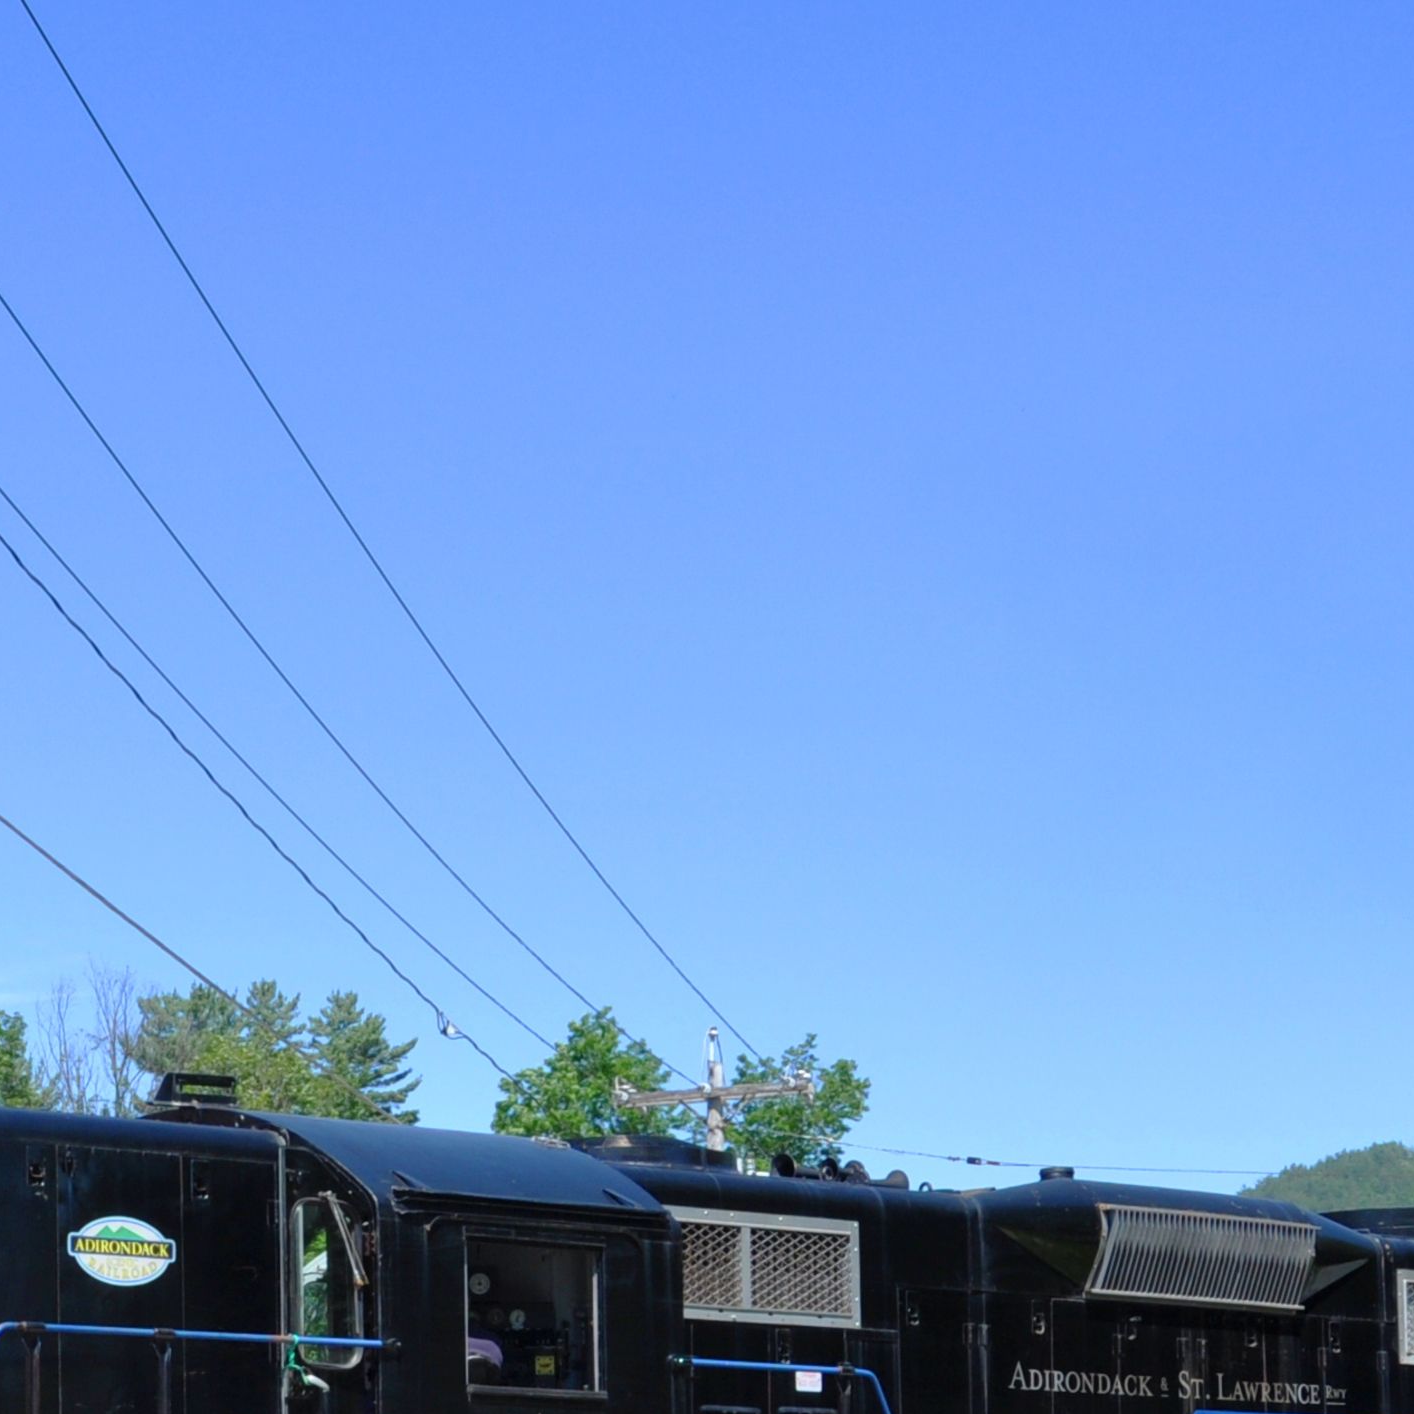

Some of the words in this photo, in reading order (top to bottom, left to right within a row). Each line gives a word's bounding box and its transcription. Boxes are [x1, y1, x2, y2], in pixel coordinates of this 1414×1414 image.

[74, 1238, 170, 1257] ADIRONDACK
[1008, 1360, 1154, 1397] ADIRONDACK
[1217, 1372, 1321, 1405] LAWRENCE
